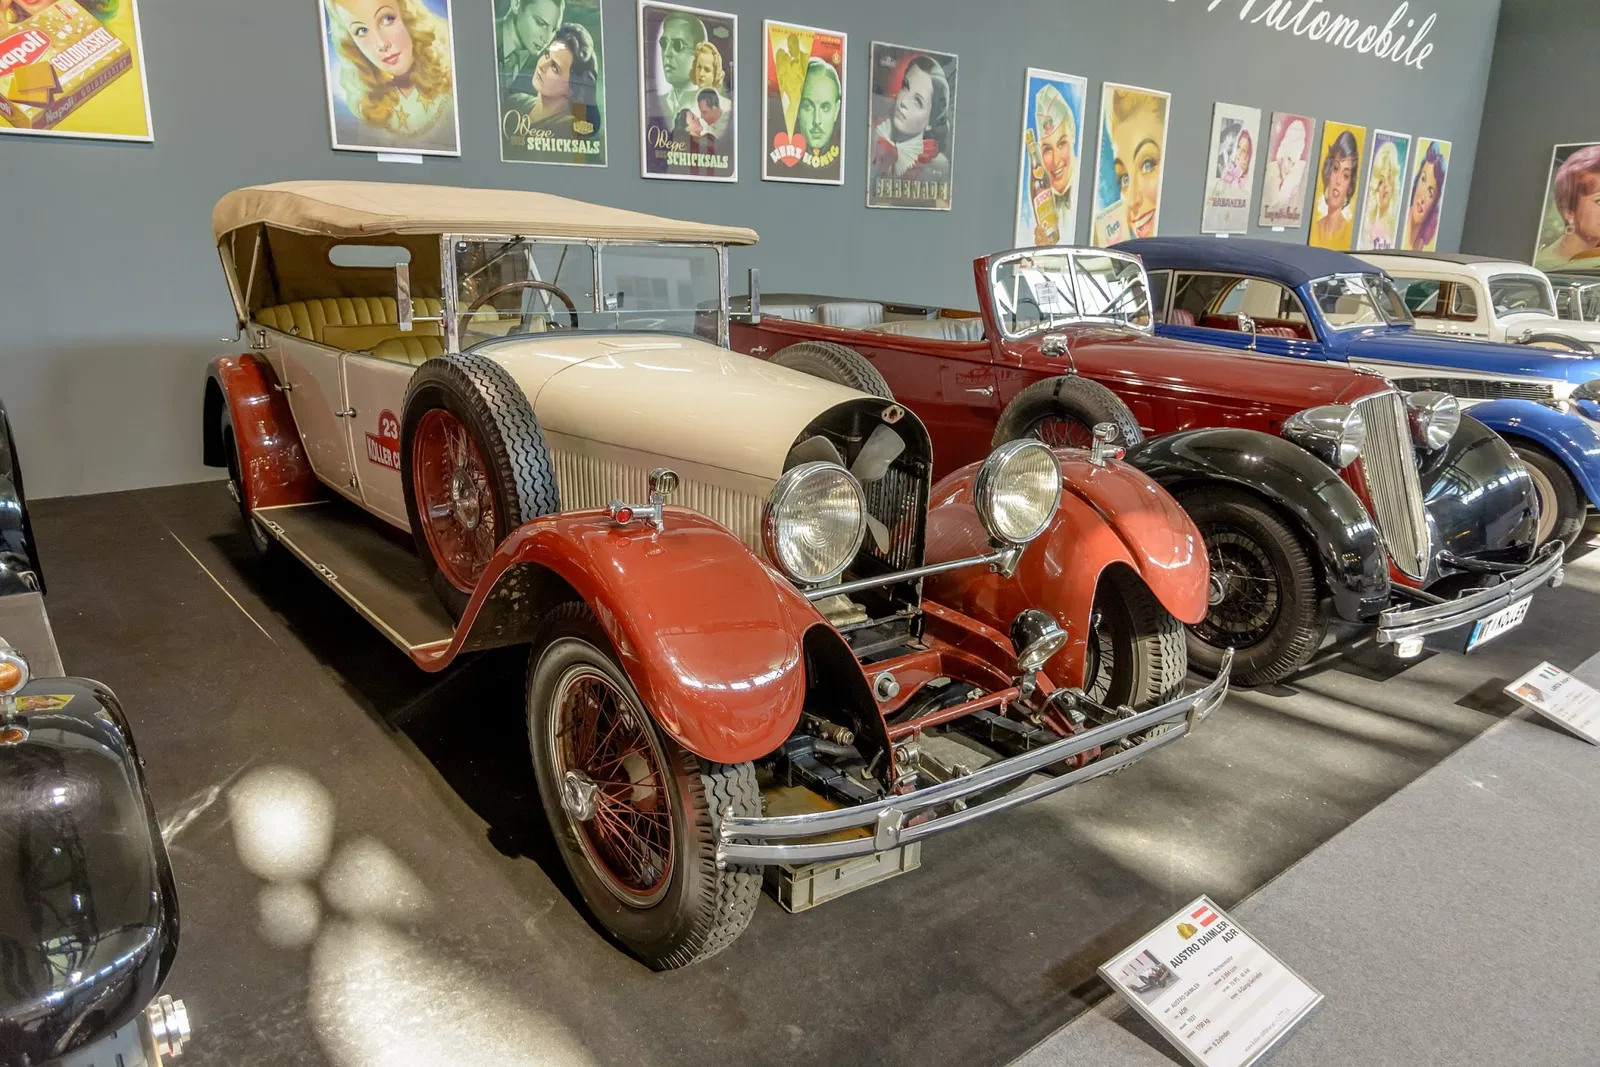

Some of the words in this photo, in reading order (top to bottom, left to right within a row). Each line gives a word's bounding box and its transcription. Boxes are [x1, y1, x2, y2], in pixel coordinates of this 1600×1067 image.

[45, 97, 74, 124] Napoli
[503, 109, 550, 138] Wege
[527, 137, 600, 154] SCHICKSALS
[648, 125, 686, 151] Wege
[667, 151, 729, 168] SCHICKSALS
[876, 178, 948, 200] SERENADE
[382, 417, 399, 440] 23
[366, 435, 393, 467] KOLLER
[1169, 942, 1200, 968] AUSTRO
[1197, 920, 1230, 946] DAIMLER
[1221, 928, 1240, 944] ADR
